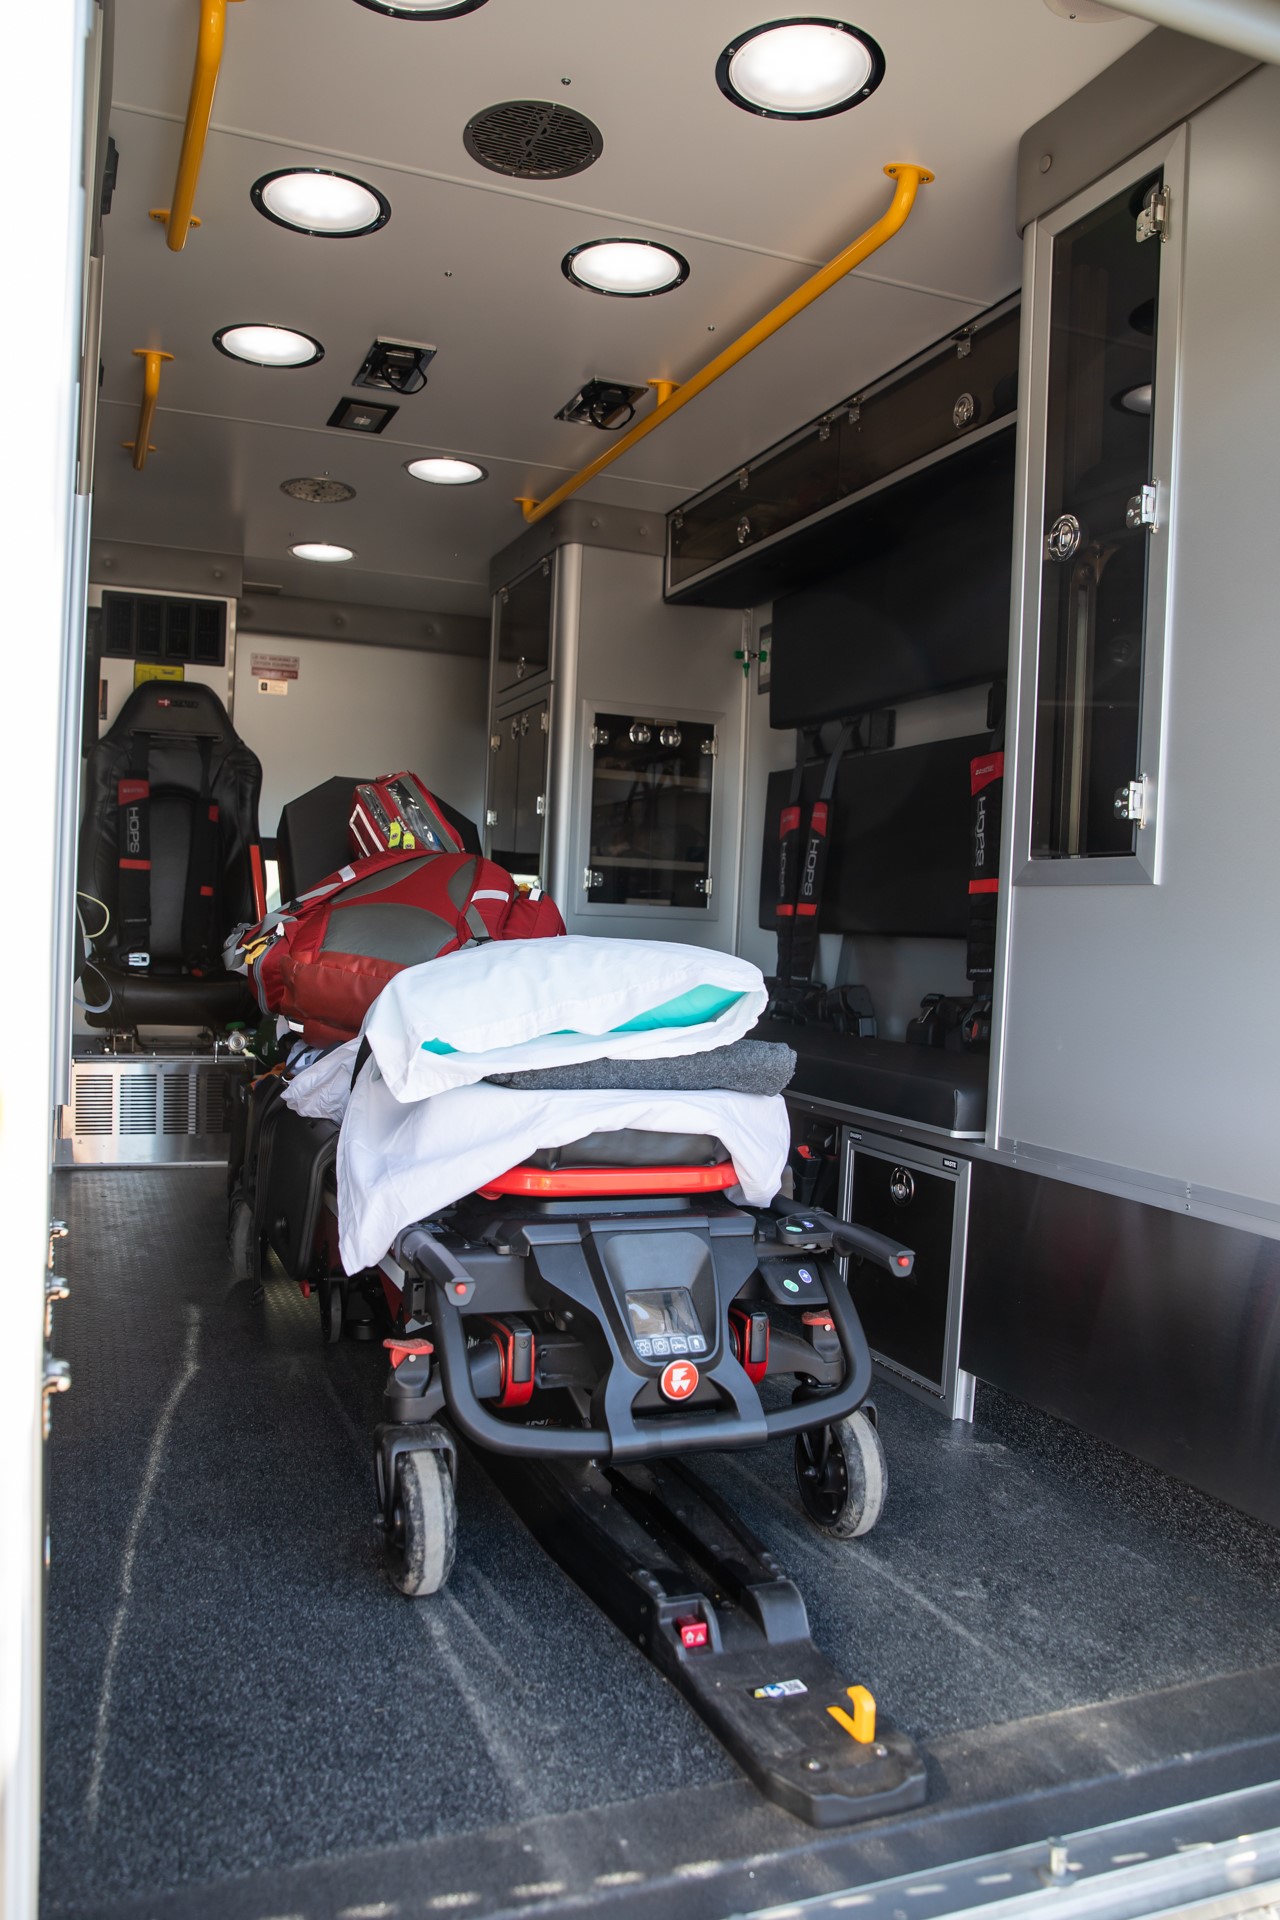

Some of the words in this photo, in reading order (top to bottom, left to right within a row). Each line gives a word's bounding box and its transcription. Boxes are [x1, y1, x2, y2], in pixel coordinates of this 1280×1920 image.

[130, 807, 140, 853] HOPS
[976, 796, 986, 866] HOPS
[804, 839, 820, 896] HOPS
[944, 1160, 957, 1169] WASTE
